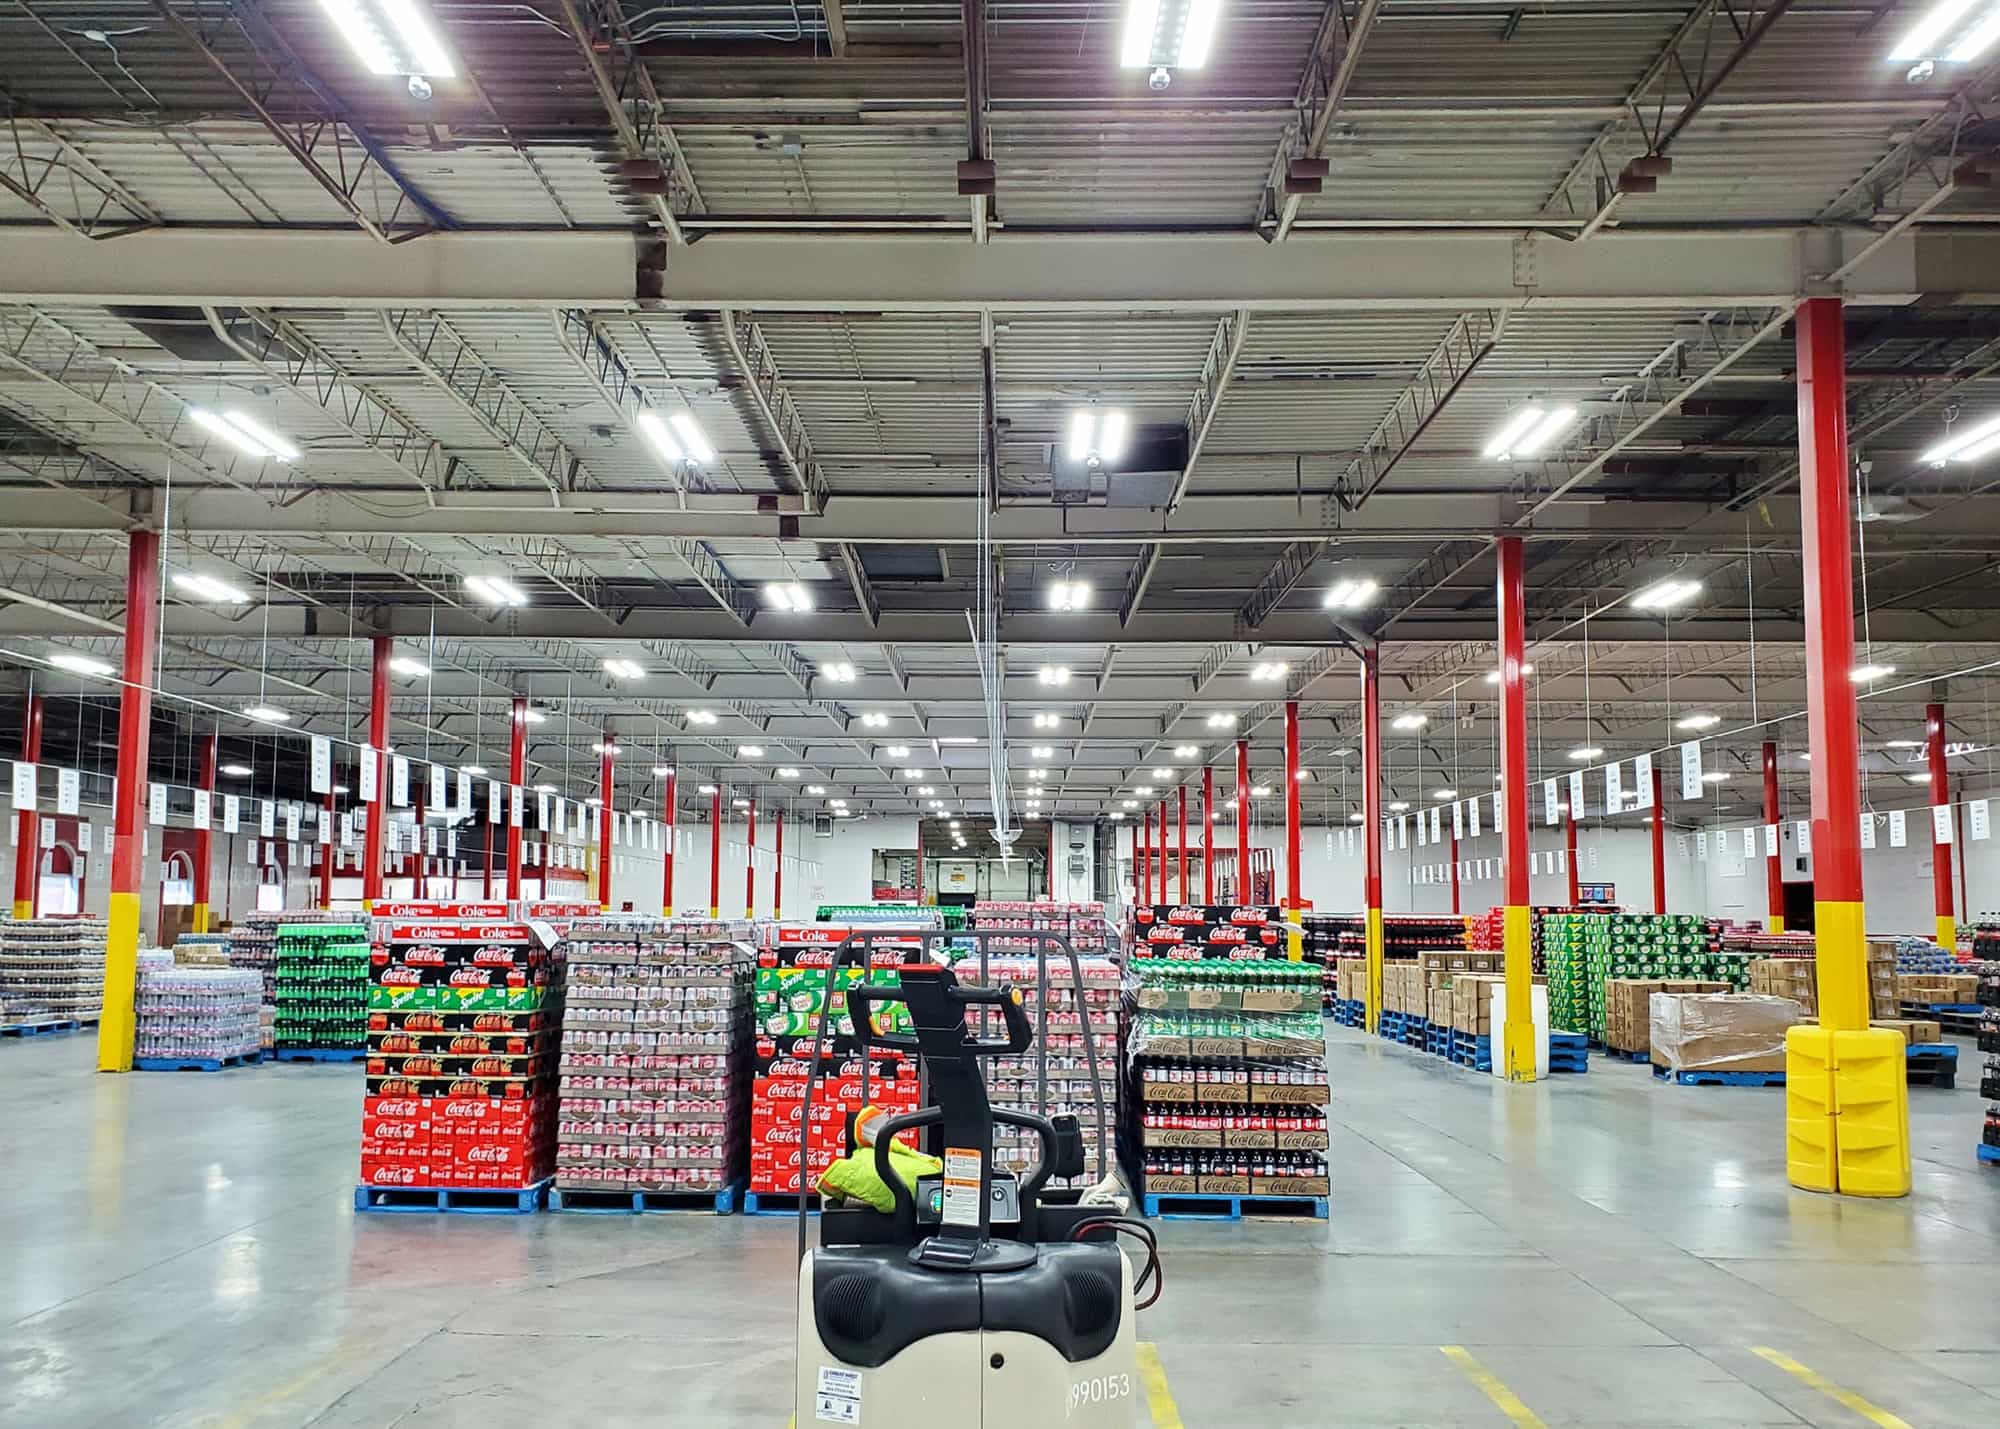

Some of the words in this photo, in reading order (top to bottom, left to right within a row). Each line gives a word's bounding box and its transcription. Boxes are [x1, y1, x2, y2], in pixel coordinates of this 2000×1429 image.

[390, 905, 417, 916] Coke
[458, 905, 485, 917] Coke
[411, 927, 438, 939] Coke
[480, 927, 507, 939] Coke
[800, 930, 828, 942] Coke
